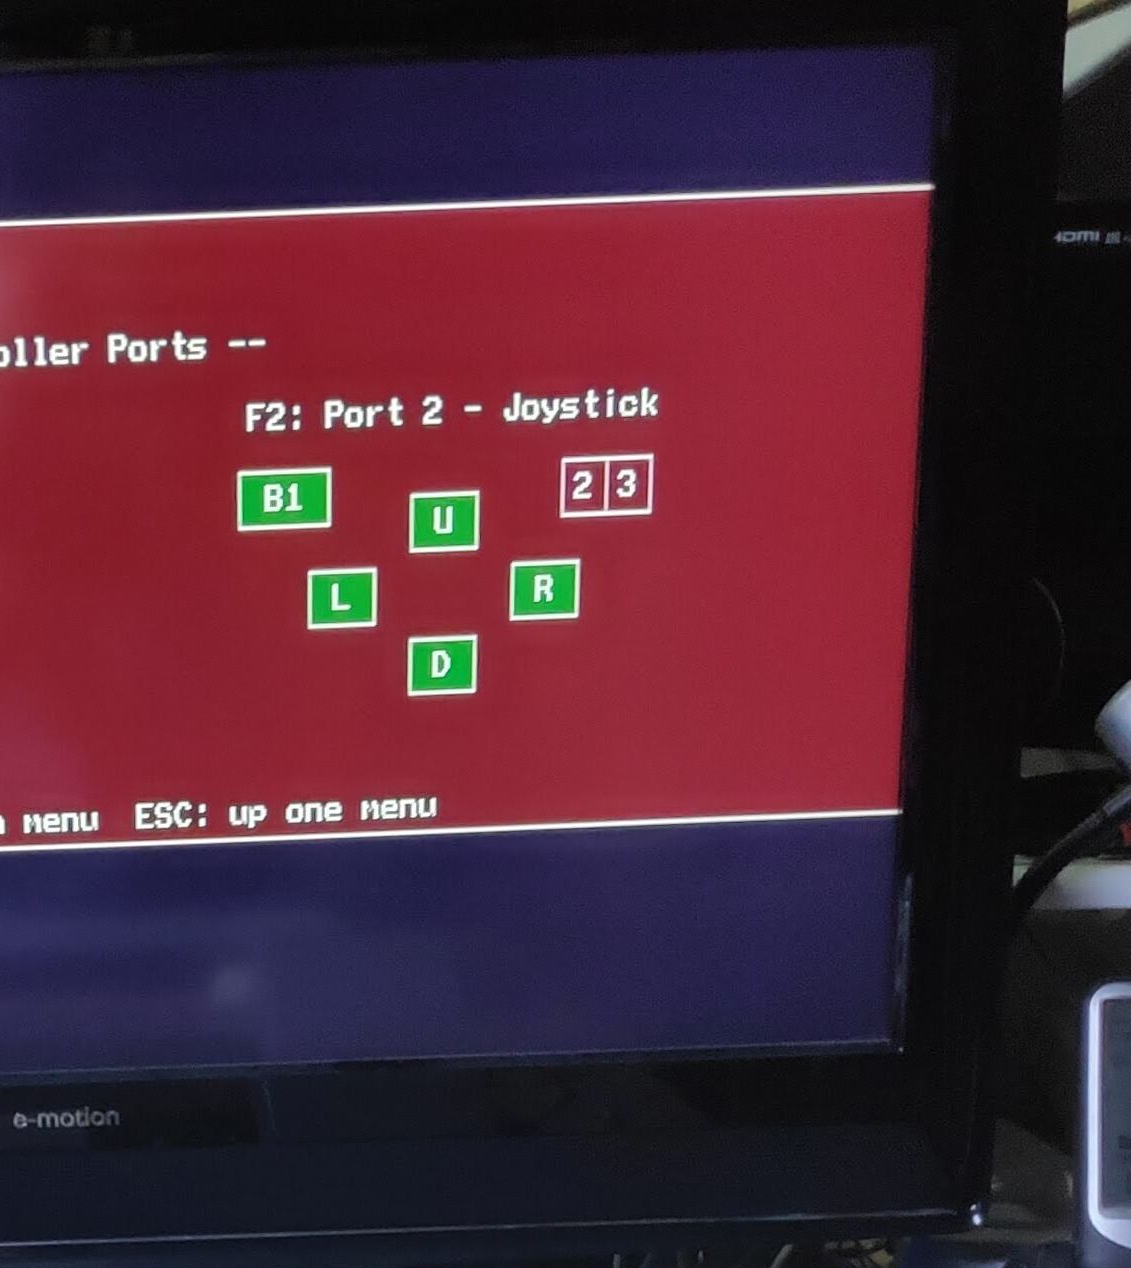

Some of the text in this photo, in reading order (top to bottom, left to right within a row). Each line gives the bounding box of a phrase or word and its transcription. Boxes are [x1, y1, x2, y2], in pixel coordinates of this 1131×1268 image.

[107, 330, 208, 364] Ports
[245, 401, 301, 433] F2:
[323, 396, 404, 430] Port
[421, 395, 444, 426] 2
[502, 386, 659, 425] Joystick
[263, 482, 303, 513] B1
[571, 470, 593, 500] 2
[615, 468, 637, 499] 3
[432, 505, 454, 535] U
[331, 582, 351, 611] L
[533, 573, 554, 603] R
[431, 649, 451, 678] D
[22, 811, 100, 834] menu
[134, 800, 207, 830] ESC:
[228, 804, 268, 829] up
[284, 801, 343, 824] one
[360, 796, 438, 821] menu
[12, 1106, 120, 1129] e-motion
